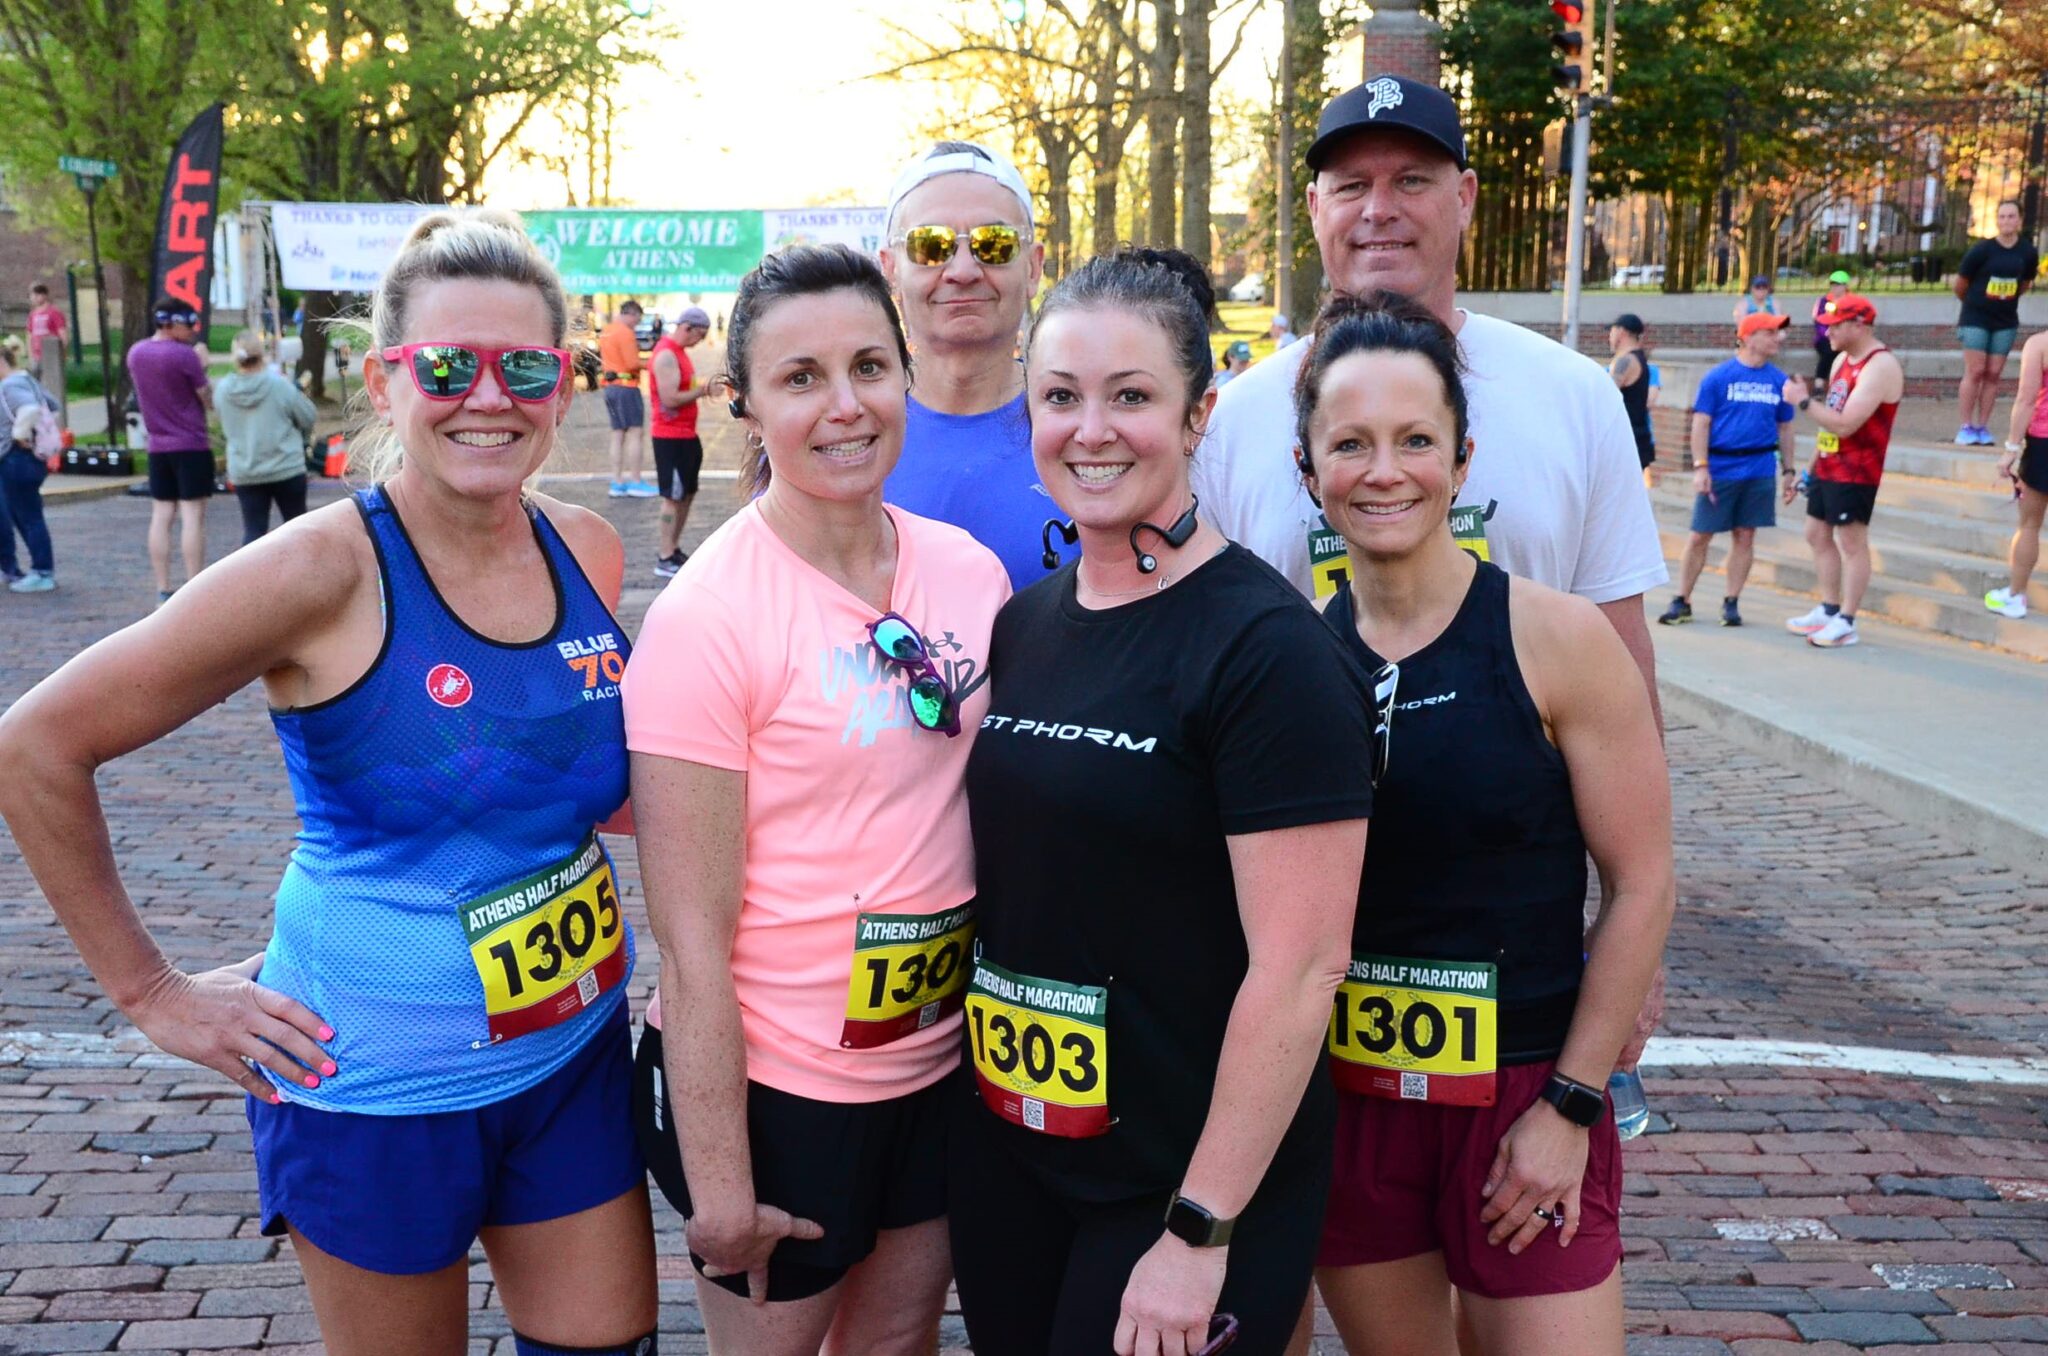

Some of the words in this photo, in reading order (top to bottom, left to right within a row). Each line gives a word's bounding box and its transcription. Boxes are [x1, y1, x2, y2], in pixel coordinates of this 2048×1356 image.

[291, 210, 353, 224] THANKS
[358, 210, 380, 225] TO
[780, 214, 838, 228] THANKS
[841, 213, 863, 226] TO
[554, 218, 738, 247] WELCOME
[601, 250, 695, 269] ATHENS
[1314, 536, 1347, 555] ATHE
[557, 633, 618, 660] BLUE
[568, 651, 625, 688] 70
[581, 684, 620, 701] RACI
[1393, 691, 1457, 711] HORM
[981, 714, 1012, 729] ST
[1012, 719, 1157, 753] PHORM
[469, 890, 527, 932] ATHENS
[525, 875, 560, 908] HALF
[559, 841, 602, 889] MARATHON
[489, 875, 619, 998] 1305
[861, 921, 919, 941] ATHENS
[919, 916, 950, 939] HALF
[866, 940, 970, 1009] 130
[1371, 965, 1408, 983] HALF
[1409, 968, 1488, 990] MARATHON
[973, 967, 1001, 996] ATHENS
[999, 977, 1023, 1003] HALF
[1025, 986, 1097, 1016] MARATHON
[1333, 991, 1477, 1062] 1301
[972, 1005, 1099, 1093] 1303
